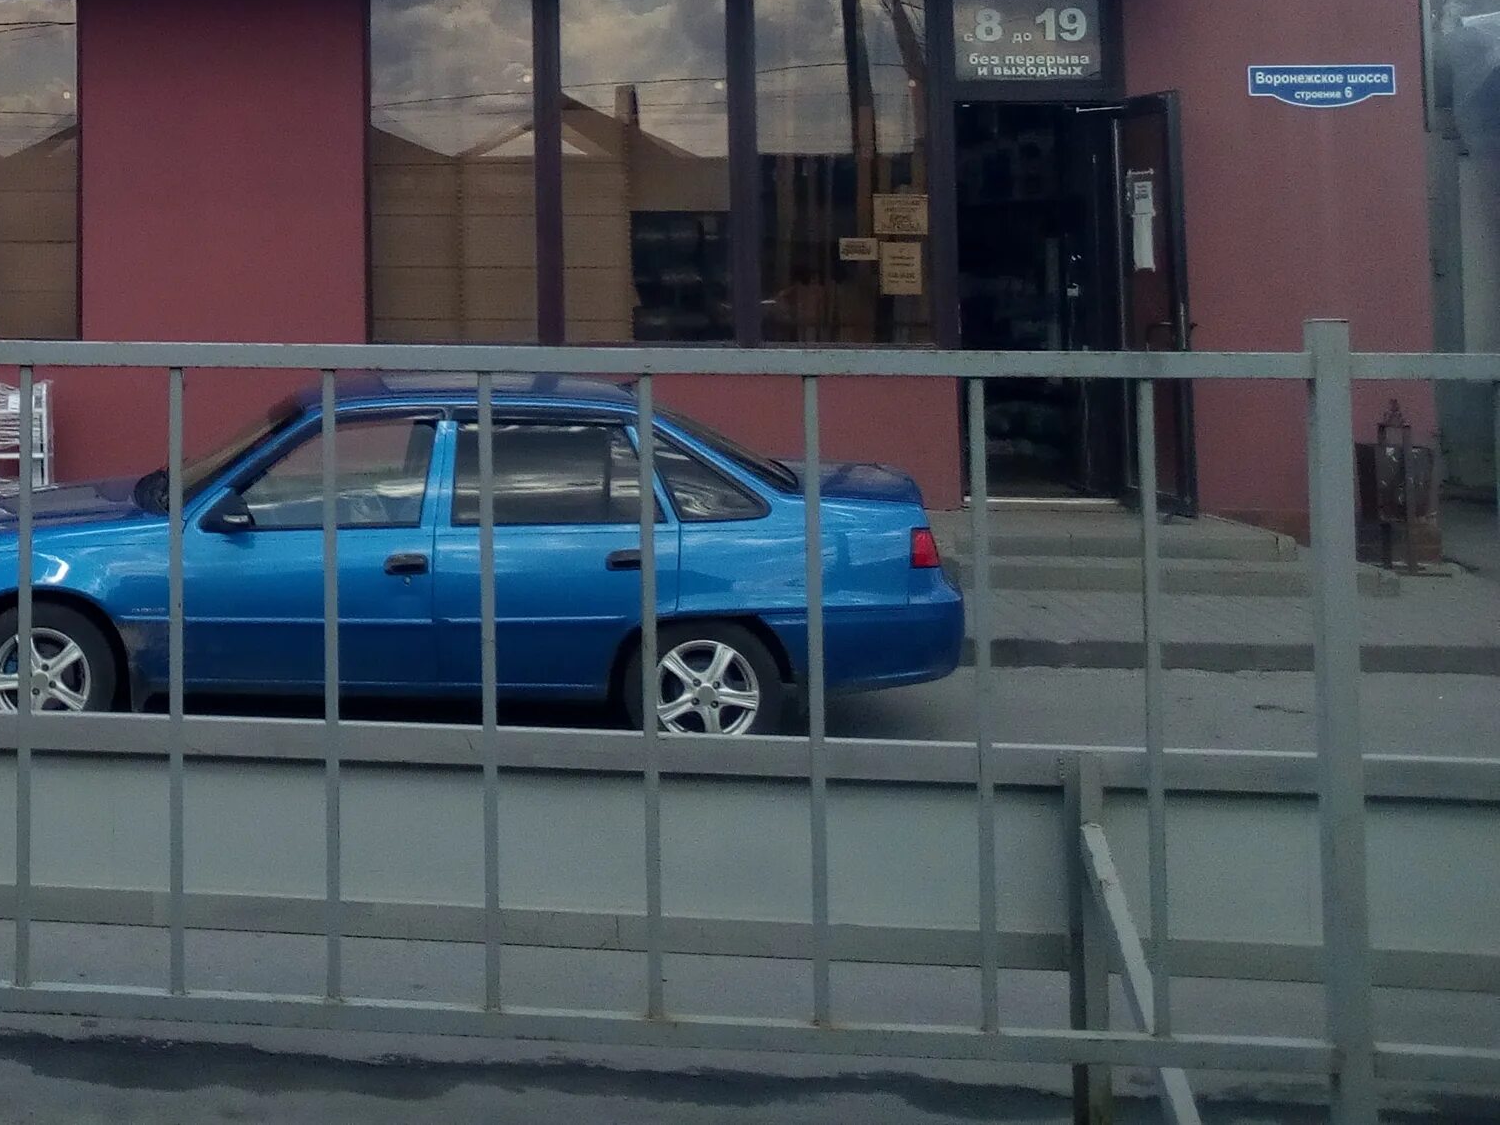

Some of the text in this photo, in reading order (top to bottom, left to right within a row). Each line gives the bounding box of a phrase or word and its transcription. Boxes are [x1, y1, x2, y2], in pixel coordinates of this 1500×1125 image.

[974, 7, 1003, 42] 8
[1012, 31, 1032, 44] до
[1035, 6, 1088, 42] 19
[968, 53, 1090, 67] без перерыва
[977, 65, 1083, 78] и выходных
[1255, 72, 1389, 86] Воронежское шоссе
[1294, 86, 1353, 100] строение 6
